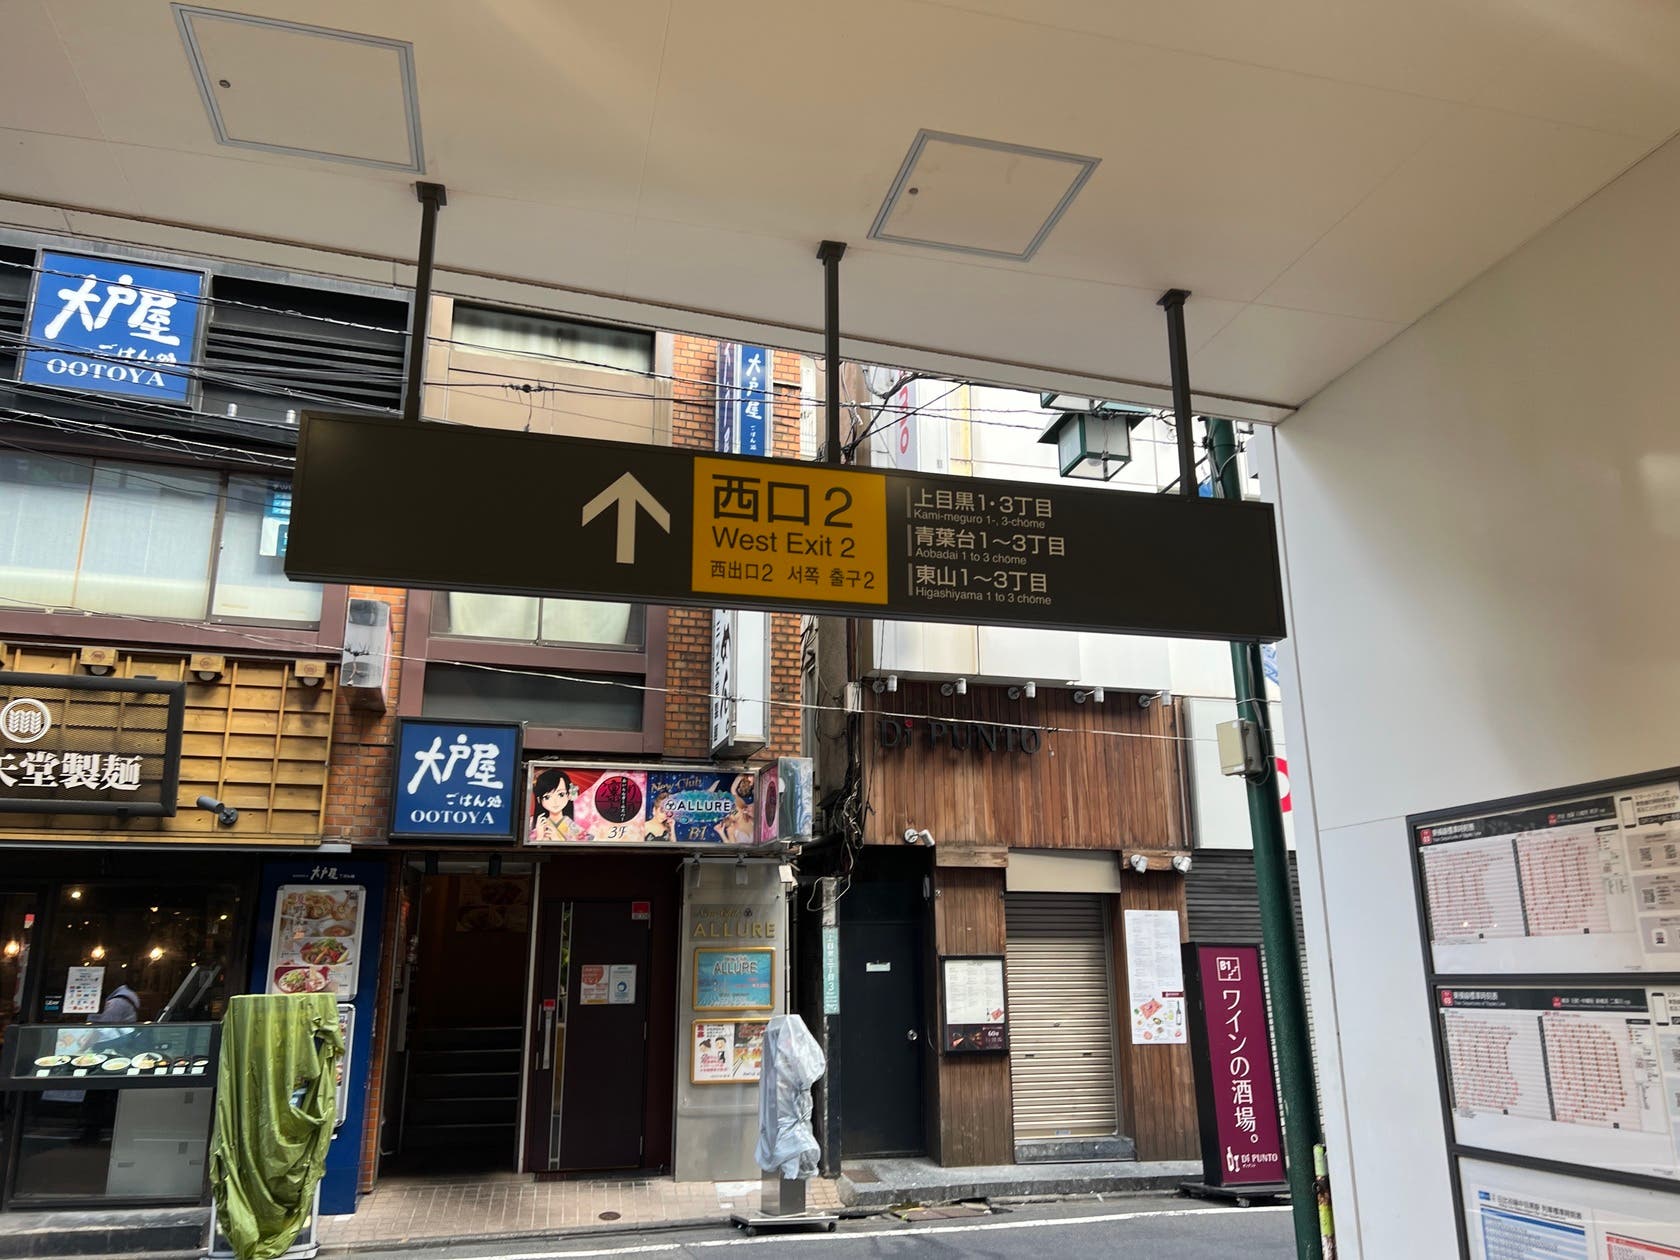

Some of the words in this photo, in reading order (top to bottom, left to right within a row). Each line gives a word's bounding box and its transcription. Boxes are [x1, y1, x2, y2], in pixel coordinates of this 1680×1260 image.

[46, 358, 165, 387] OOTOYA
[913, 508, 983, 525] Kami-meguro
[1001, 517, 1046, 529] 3-chome
[712, 526, 777, 553] West
[787, 532, 832, 557] Exit
[840, 537, 855, 559] 2
[915, 547, 959, 562] Aobadai
[962, 551, 967, 560] 1
[970, 552, 981, 563] to
[983, 553, 990, 563] 3
[992, 553, 1027, 566] chome
[710, 560, 774, 582] 西出口2
[787, 565, 820, 585] 서쪽
[829, 568, 875, 590] 출구2
[915, 585, 983, 602] Higashiyama
[986, 591, 991, 601] 1
[995, 592, 1005, 602] to
[1007, 593, 1015, 603] 3
[1017, 593, 1052, 606] chome
[928, 722, 1042, 754] PUNTO
[407, 733, 504, 795] 大戸屋
[410, 809, 495, 825] OOTOYA
[677, 800, 732, 813] ALLURE
[693, 922, 776, 938] ALLURE
[713, 960, 758, 975] ALLURE
[1219, 960, 1232, 971] B1
[1222, 990, 1258, 1143] ワインの酒場。
